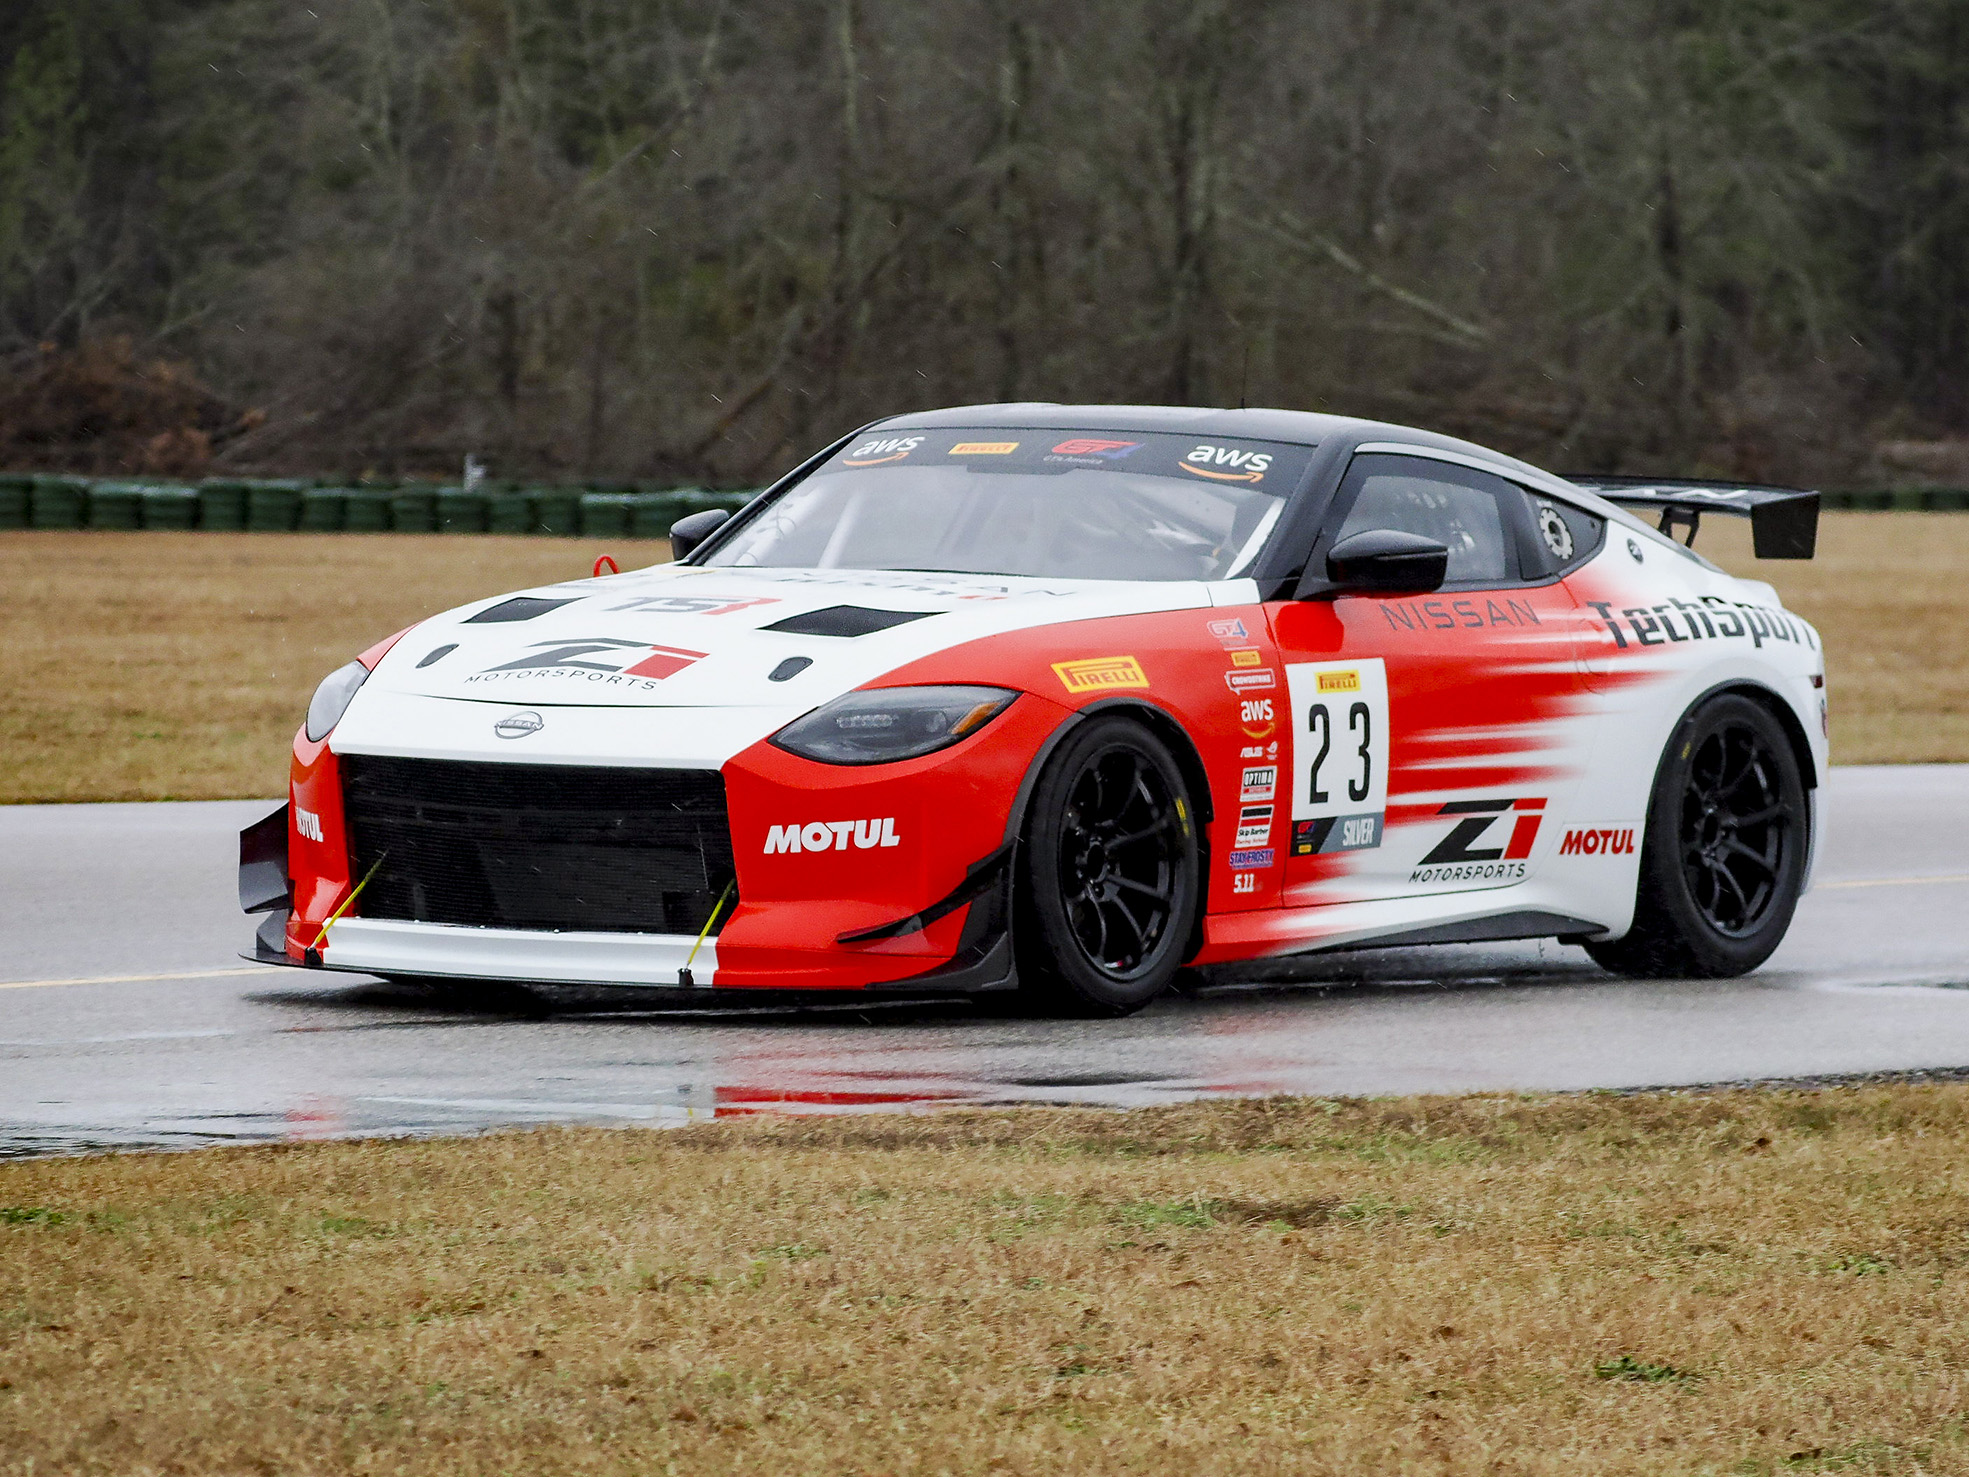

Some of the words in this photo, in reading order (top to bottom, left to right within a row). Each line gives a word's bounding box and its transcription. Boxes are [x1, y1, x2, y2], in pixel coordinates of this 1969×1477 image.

[853, 436, 925, 457] aws
[1187, 445, 1273, 472] aws
[1379, 599, 1541, 631] NISSAN
[464, 668, 657, 691] MOTORSPORTS
[1061, 661, 1141, 687] PIRELLI
[1318, 673, 1358, 690] PIRELLI
[1241, 699, 1274, 722] aws
[1309, 702, 1371, 804] 23
[1244, 771, 1273, 786] OPTIMA
[763, 817, 901, 854] MOTUL
[1342, 818, 1375, 846] SILVER
[1558, 829, 1635, 856] MOTUL
[1408, 863, 1525, 883] MOTORSPORTS
